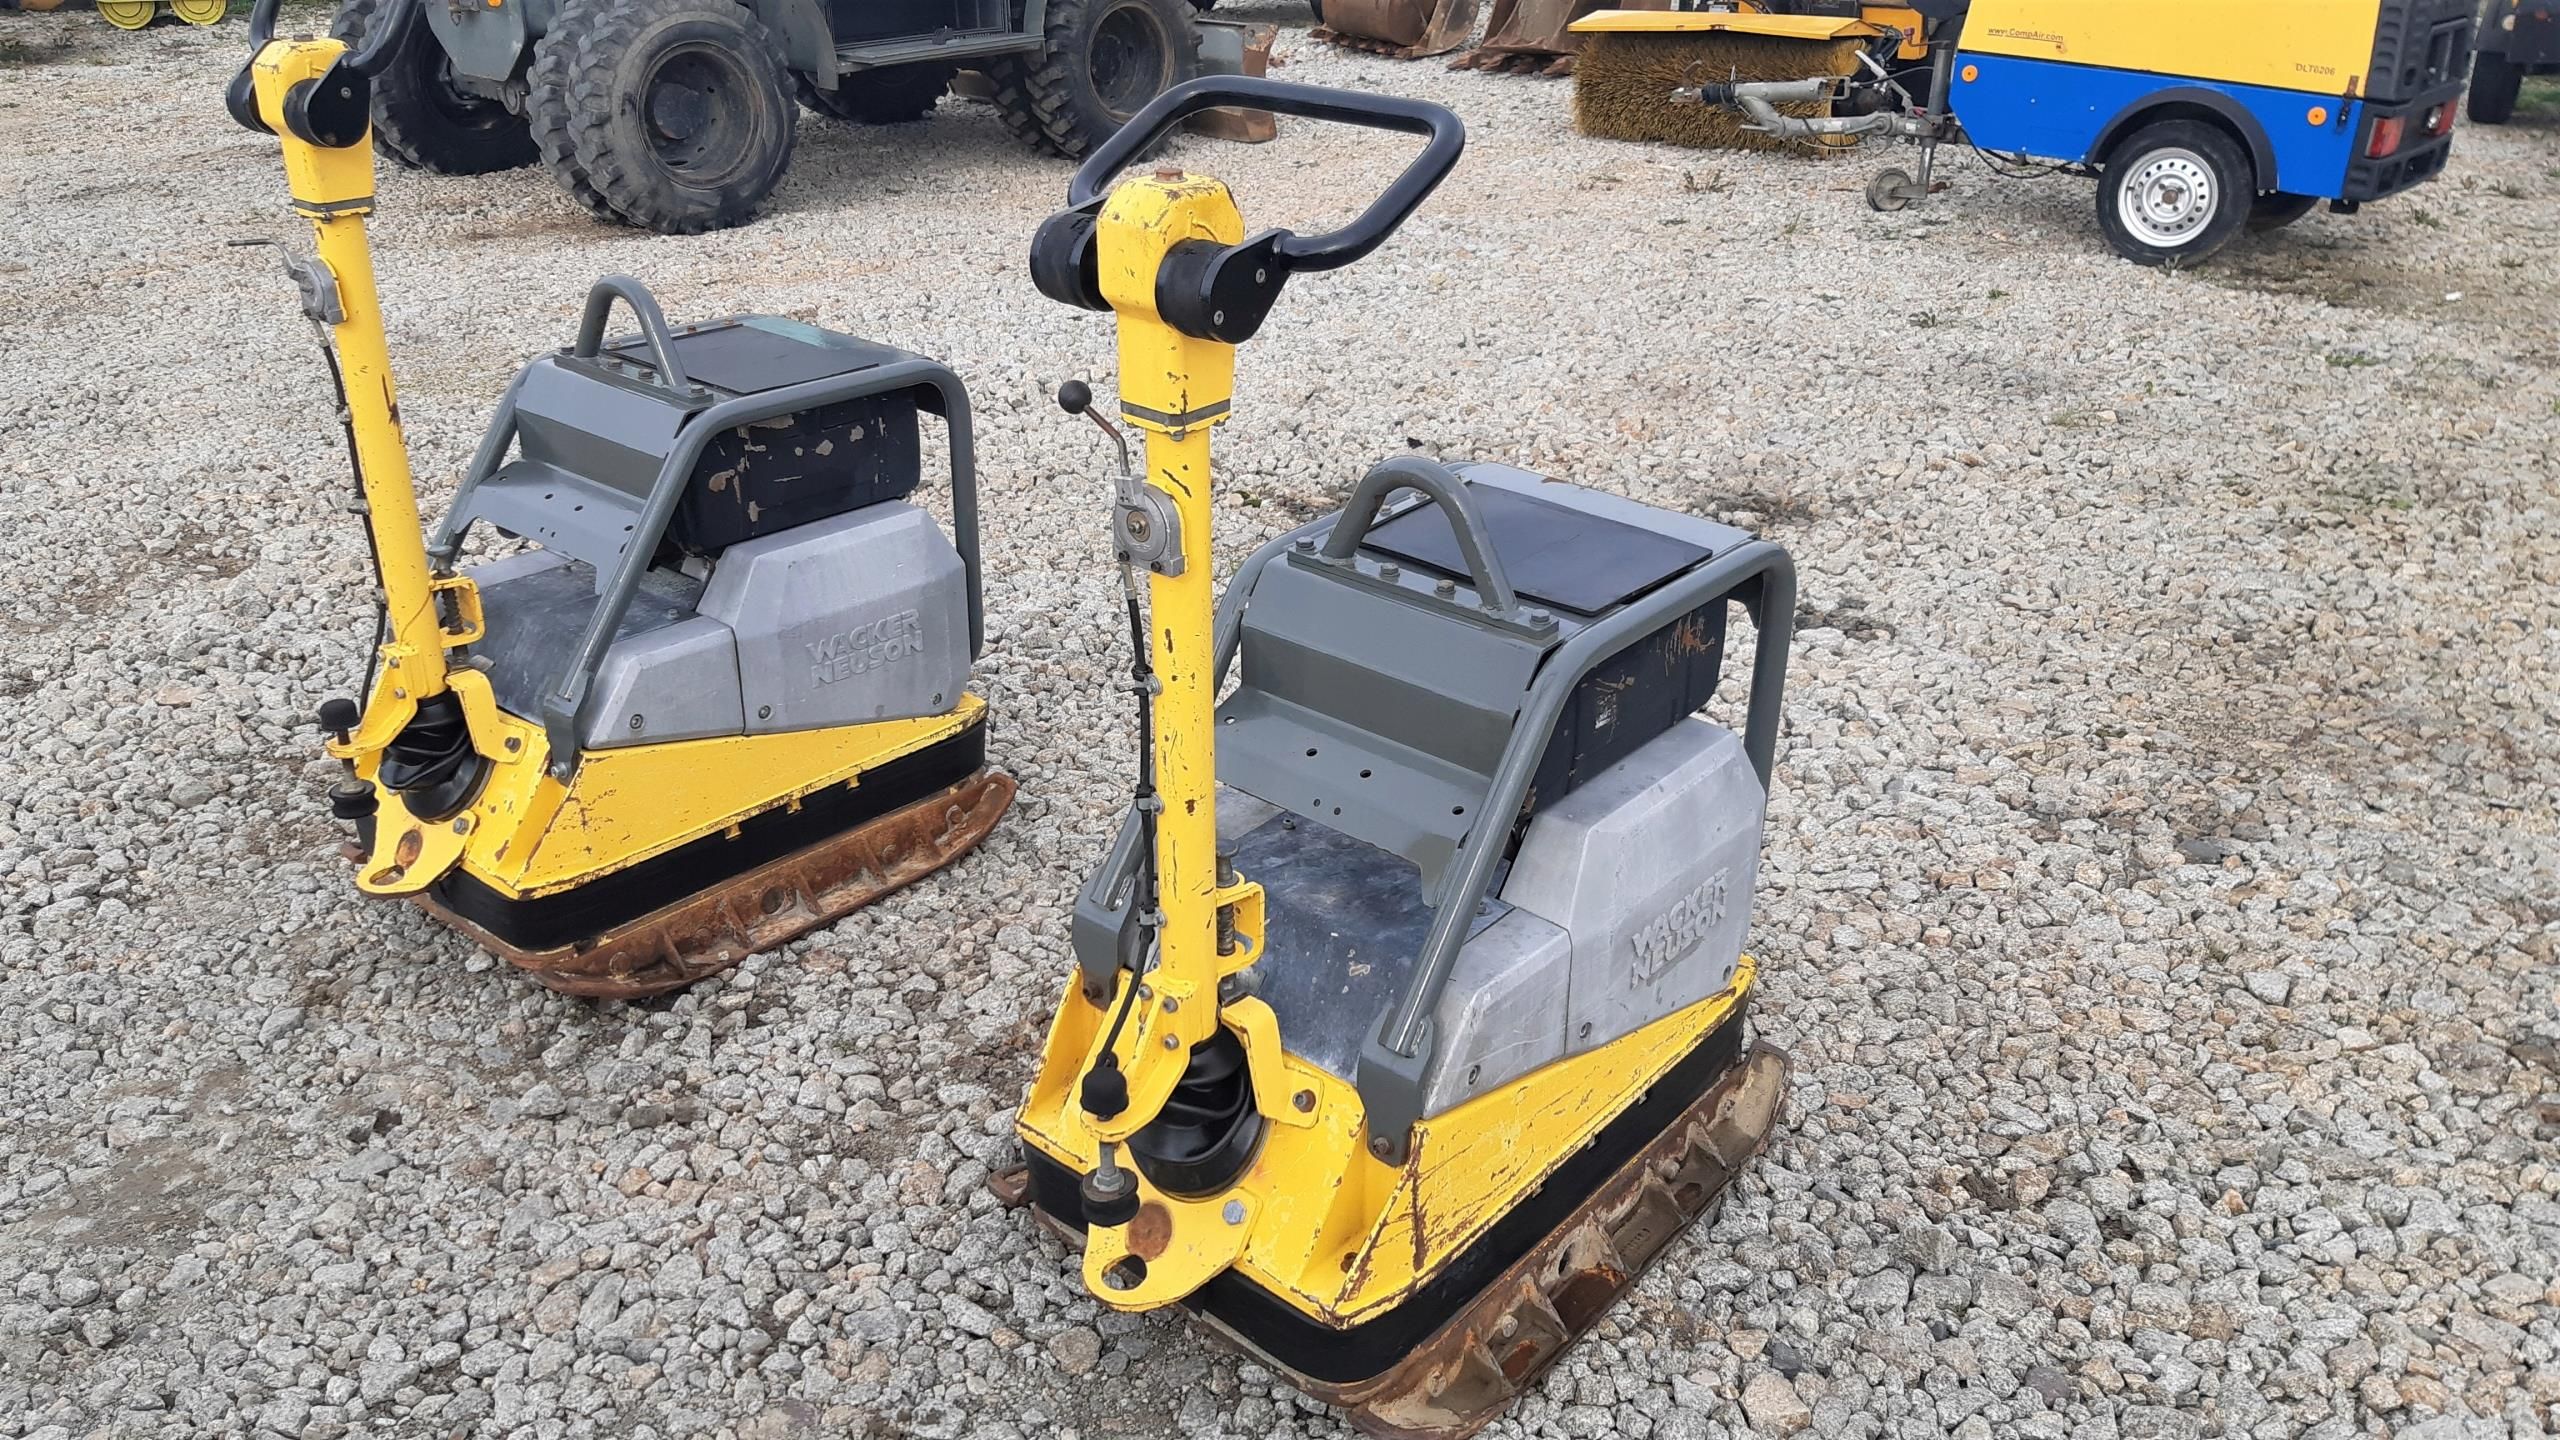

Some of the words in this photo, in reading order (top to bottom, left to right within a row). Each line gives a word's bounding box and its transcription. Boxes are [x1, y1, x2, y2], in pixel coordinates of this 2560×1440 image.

[806, 608, 922, 664] WACKER
[810, 629, 924, 689] NEUSON
[1630, 900, 1727, 990] NEUSON
[1631, 867, 1730, 958] WACKER
